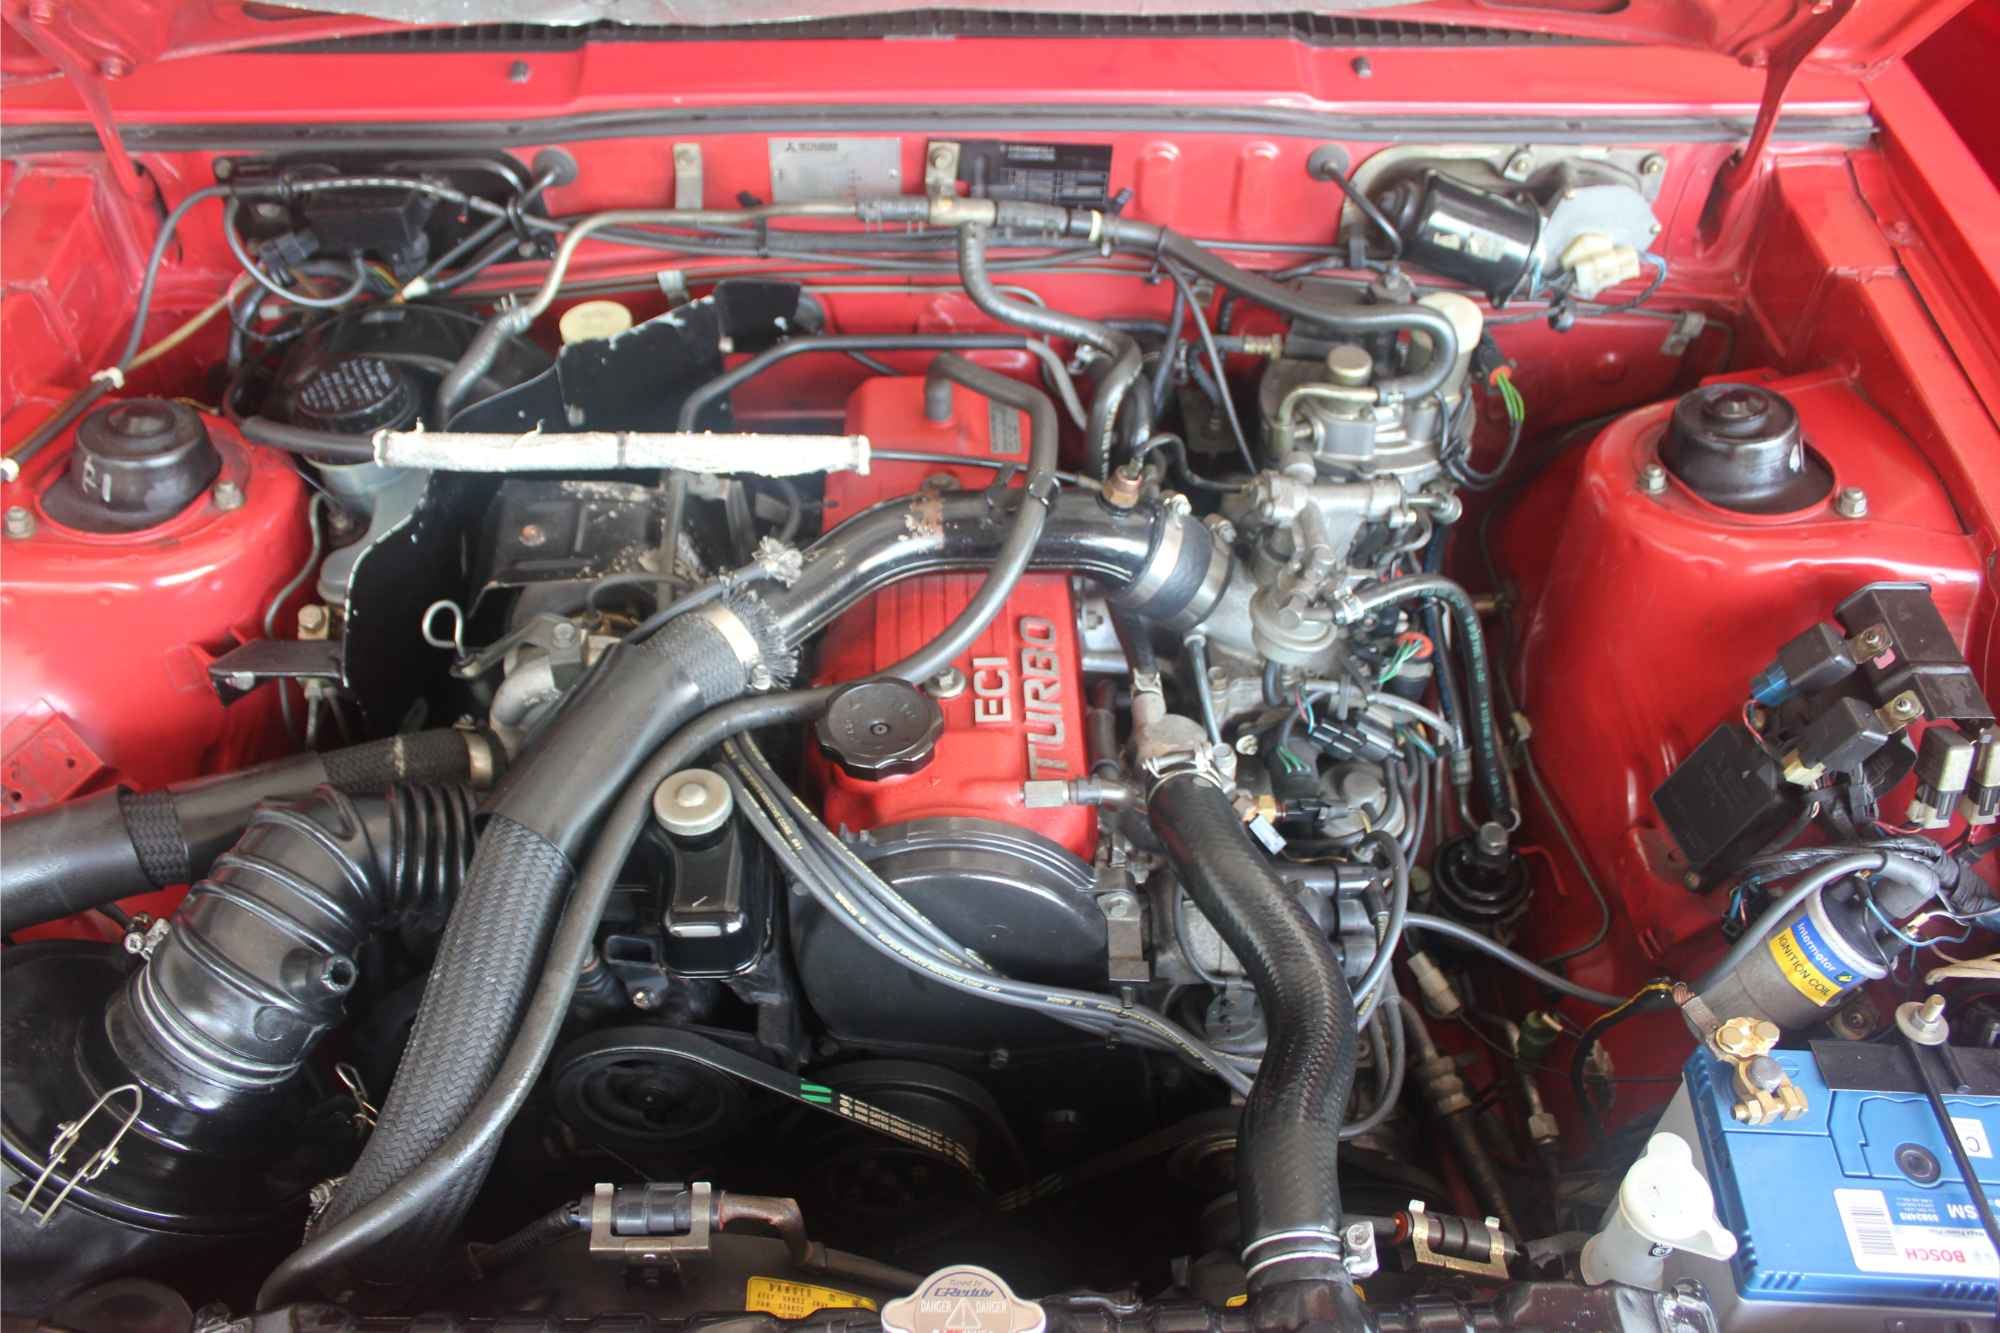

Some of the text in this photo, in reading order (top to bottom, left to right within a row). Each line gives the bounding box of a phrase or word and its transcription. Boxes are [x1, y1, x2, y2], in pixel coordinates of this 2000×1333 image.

[972, 657, 1012, 722] ECI
[1020, 617, 1067, 780] TURBO
[760, 792, 781, 818] INDUCTIVE
[778, 818, 793, 835] CORE
[835, 892, 858, 916] BOSCH
[1797, 922, 1837, 972] Intermotor
[877, 934, 901, 952] SUPER
[900, 950, 928, 967] SPORTS
[927, 965, 965, 982] INDUCTIVE
[963, 980, 984, 988] CORE
[1778, 934, 1831, 996] IGNITION COIL
[1047, 997, 1072, 1005] BOSCH
[1097, 1004, 1121, 1013] SUPER
[1122, 1010, 1150, 1024] SPORTS
[1149, 1022, 1182, 1044] INDUCTIVE
[1182, 1044, 1200, 1058] CORE
[869, 1112, 889, 1124] GATES
[890, 1120, 910, 1132] GREEN
[911, 1128, 931, 1140] STRIPE
[869, 1119, 889, 1131] GATES
[890, 1127, 910, 1139] GREEN
[911, 1135, 931, 1148] STRIPE
[1899, 1212, 1940, 1222] 55B24RS
[1946, 1204, 1978, 1220] SM
[1905, 1248, 1966, 1263] BOSCH
[757, 1292, 774, 1300] KEEP
[783, 1296, 805, 1305] HANDS
[769, 1283, 811, 1297] DANGER
[934, 1288, 995, 1298] GReddy
[779, 1303, 804, 1313] STARTS
[920, 1300, 951, 1313] DANGER
[976, 1301, 1007, 1313] DANGER
